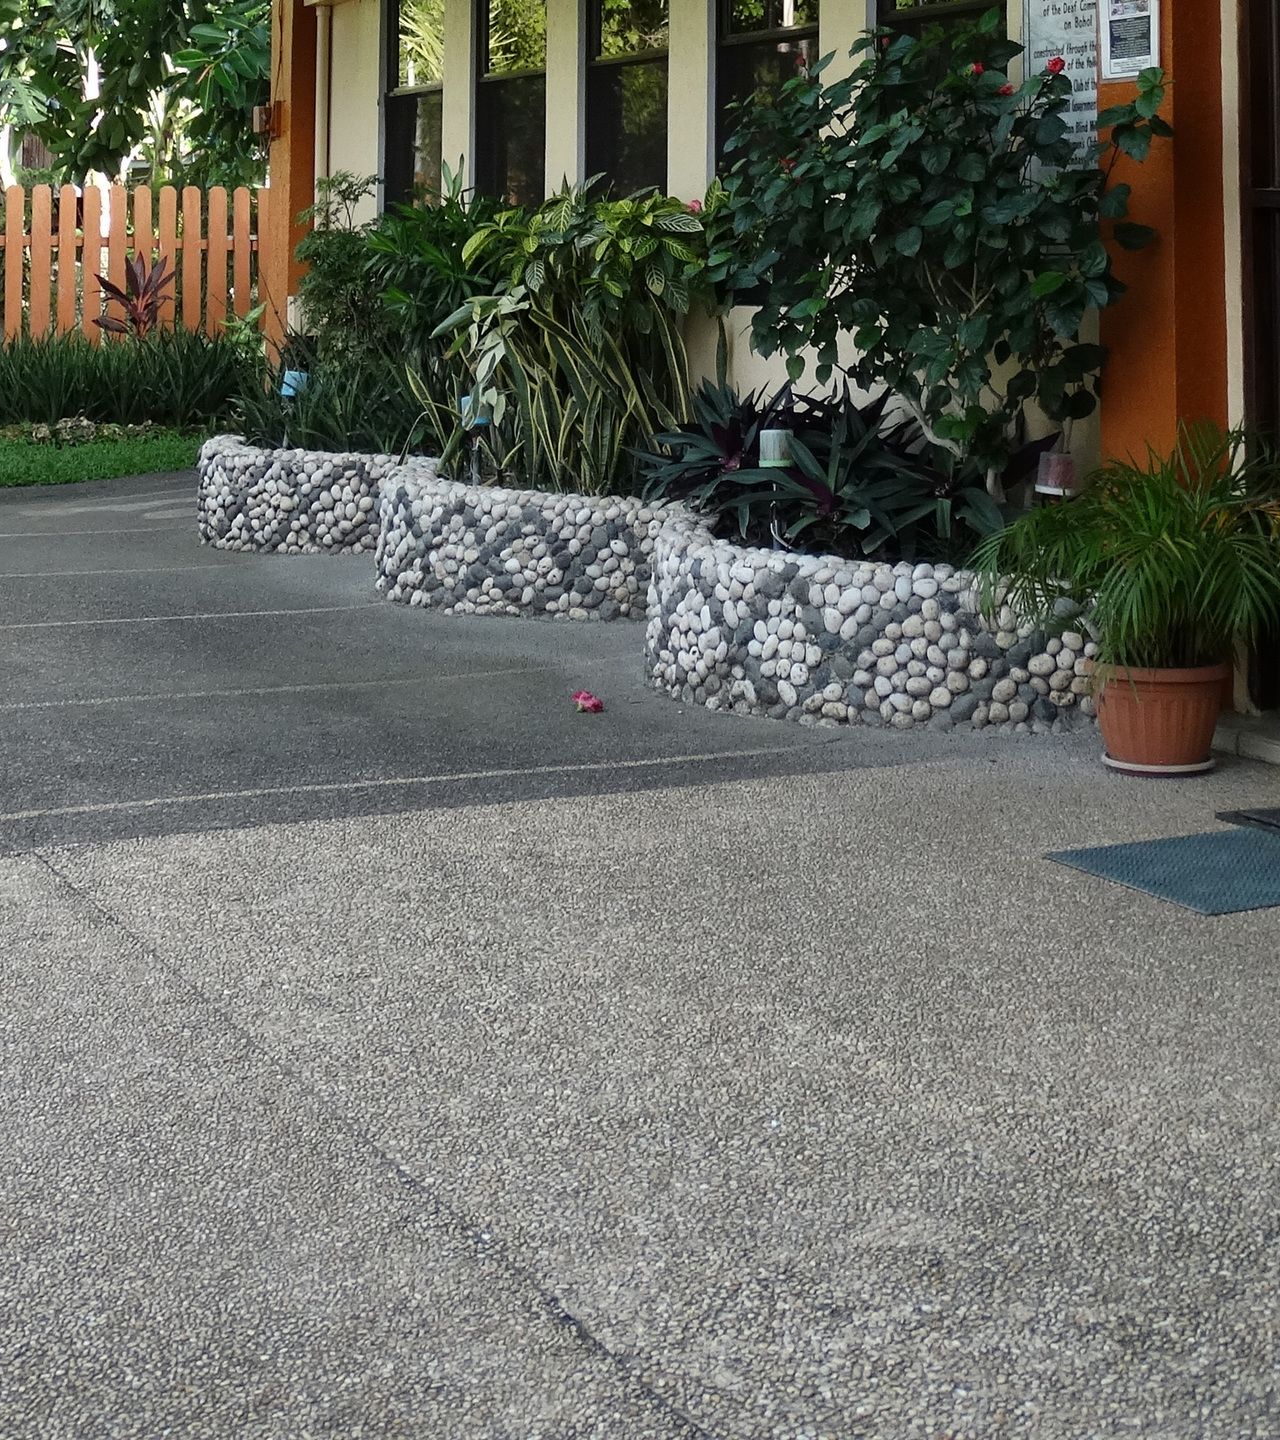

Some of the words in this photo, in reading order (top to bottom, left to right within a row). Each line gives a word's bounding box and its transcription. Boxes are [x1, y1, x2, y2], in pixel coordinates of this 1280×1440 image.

[1043, 5, 1050, 16] of
[1051, 3, 1061, 15] the
[1063, 0, 1077, 14] Deaf
[1063, 21, 1071, 30] on
[1074, 15, 1093, 28] Bohol
[1033, 44, 1064, 59] constructed
